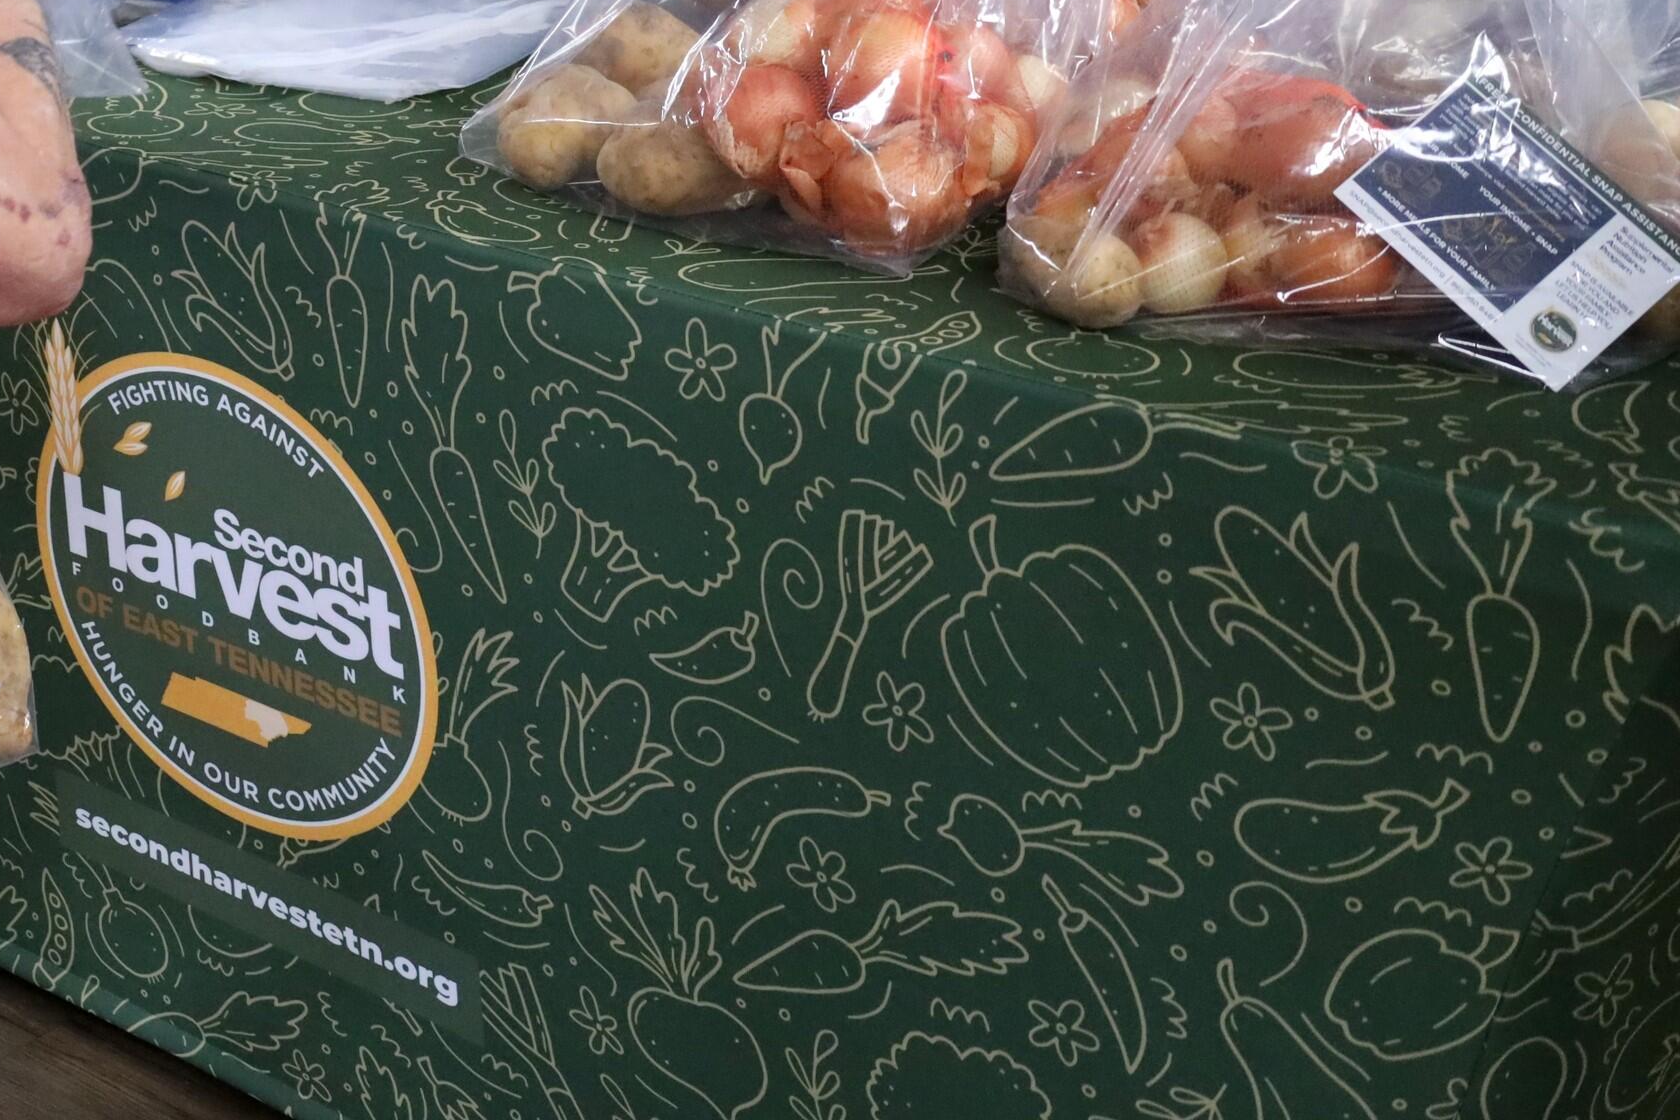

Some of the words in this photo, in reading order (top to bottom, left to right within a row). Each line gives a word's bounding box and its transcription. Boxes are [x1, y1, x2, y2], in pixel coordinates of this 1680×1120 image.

[1514, 108, 1592, 177] CONFIDENTIAL
[1590, 173, 1624, 204] SNAP
[1381, 189, 1406, 213] MORE
[1427, 231, 1447, 250] FOR
[1444, 246, 1468, 268] YOUR
[1465, 264, 1496, 293] FAMILY
[1477, 185, 1501, 207] YOUR
[1498, 203, 1531, 233] INCOME
[1534, 234, 1558, 256] SNAP
[107, 380, 209, 415] FIGHTING
[216, 393, 325, 480] AGAINST
[63, 471, 404, 680] Harvest
[213, 508, 365, 597] Second
[75, 586, 113, 620] OF
[123, 599, 200, 654] EAST
[207, 635, 403, 738] TENNESSEE
[81, 620, 164, 738] HUNGER
[169, 736, 196, 767] IN
[203, 762, 260, 803] OUR
[268, 737, 397, 812] COMMUNITY
[75, 807, 459, 1007] secondharvestetn.org
